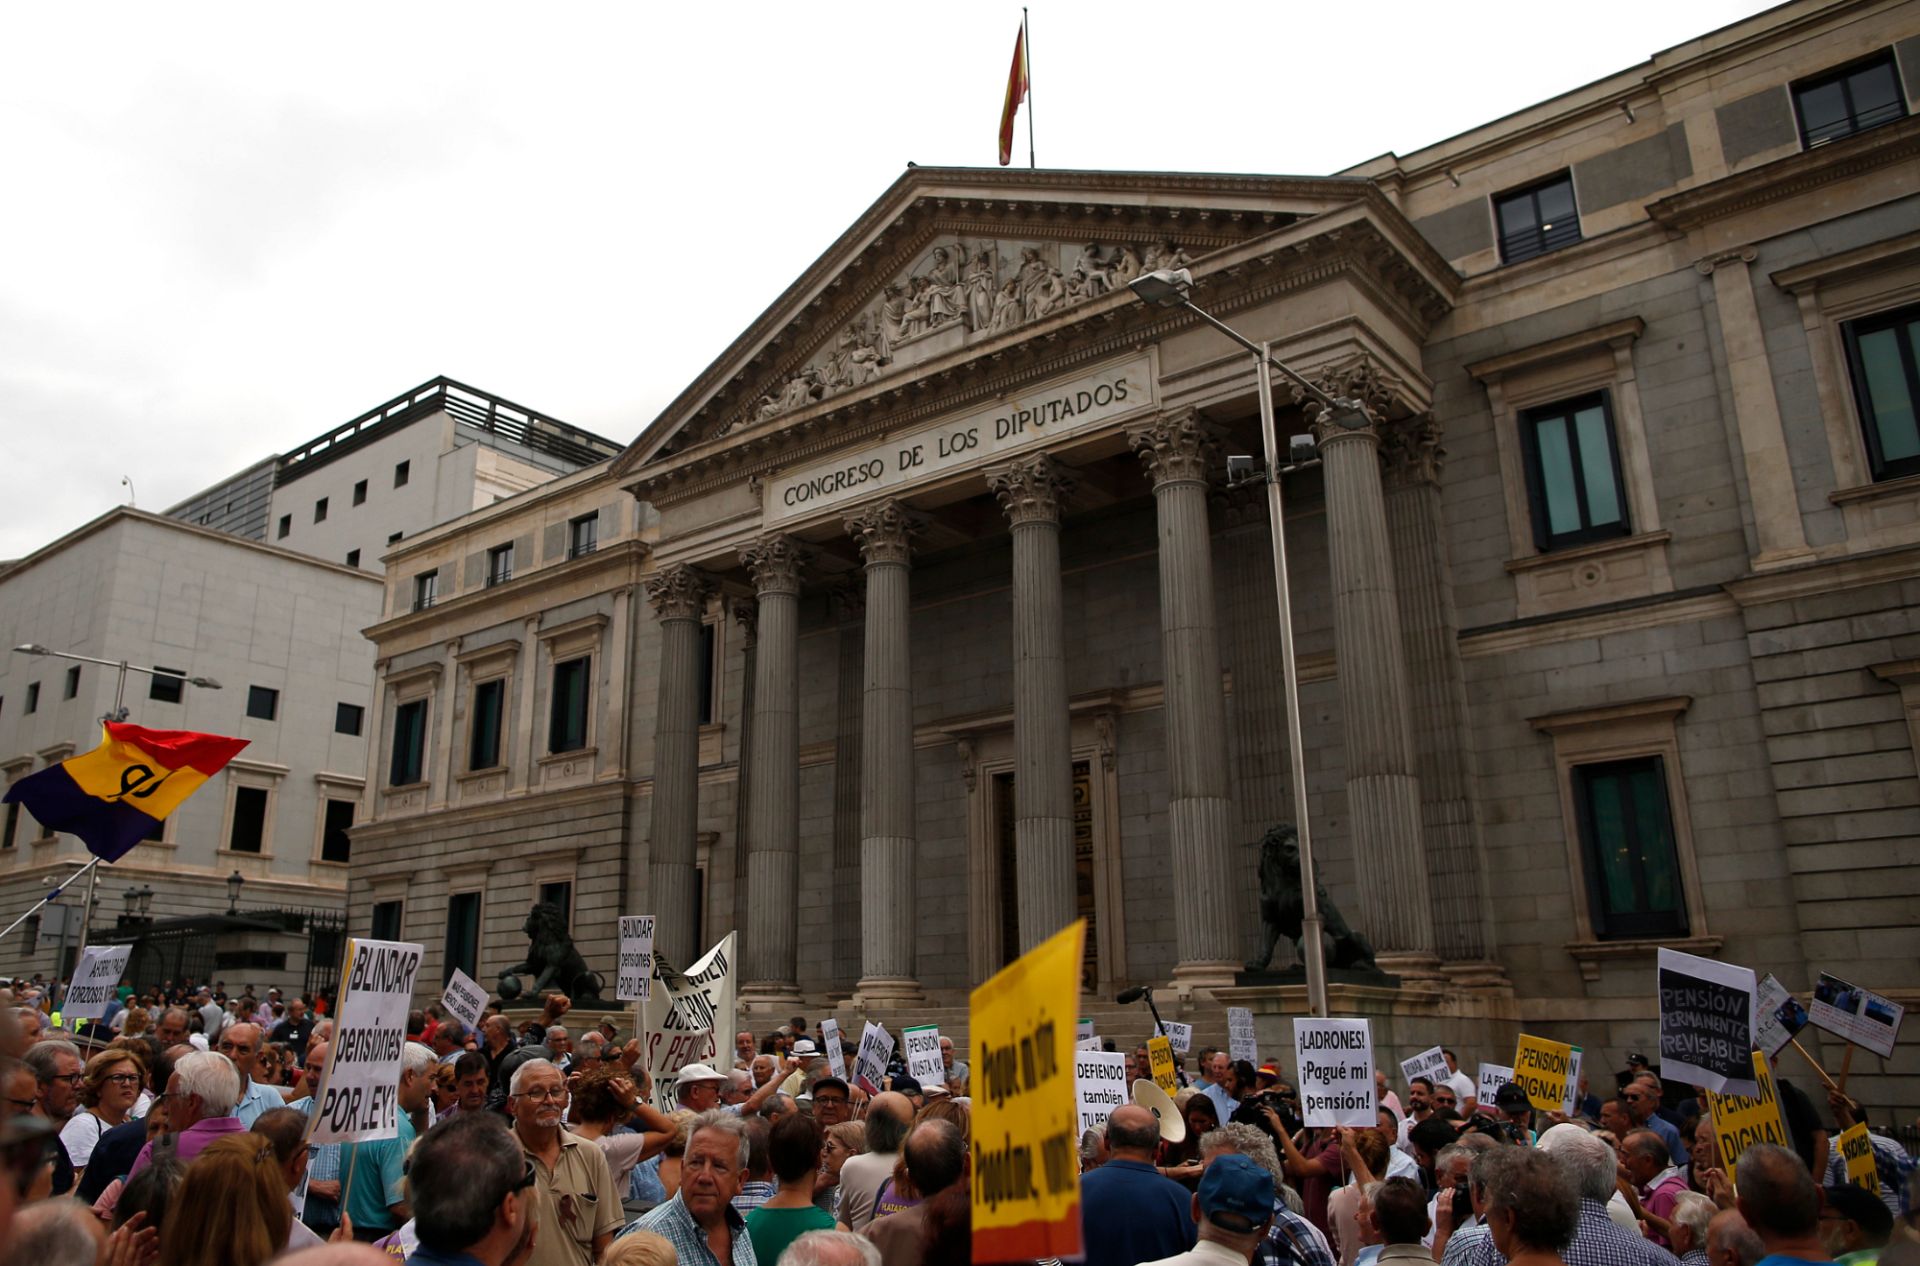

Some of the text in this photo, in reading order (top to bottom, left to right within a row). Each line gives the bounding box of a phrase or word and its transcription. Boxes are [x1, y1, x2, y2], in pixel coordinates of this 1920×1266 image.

[784, 378, 1128, 506] CONGRESO DE LOS DIPUTADOS
[620, 918, 654, 943] ¡BLINDAR
[620, 948, 651, 972] pensiones
[345, 945, 419, 1003] ¡BLINDAR
[618, 977, 650, 997] POR LEY!
[1661, 985, 1744, 1016] PENSIÓN
[1661, 1010, 1749, 1041] PERMANENTE
[332, 1017, 403, 1074] pensiones
[907, 1032, 939, 1057] ¡PENSIÓN
[1299, 1030, 1365, 1055] ¡LADRONES!
[1662, 1033, 1747, 1064] REVISABLE
[1077, 1063, 1124, 1081] DEFIENDO
[1303, 1060, 1368, 1085] ¡Pagué mi
[1517, 1046, 1567, 1075] ¡PENSIÓN
[1482, 1072, 1493, 1086] LA
[1515, 1075, 1564, 1104] DIGNA!
[314, 1085, 396, 1133] POR LEY!
[1083, 1088, 1123, 1105] también
[1307, 1091, 1370, 1115] pensión!
[1480, 1090, 1489, 1104] MI
[1082, 1112, 1094, 1128] TU
